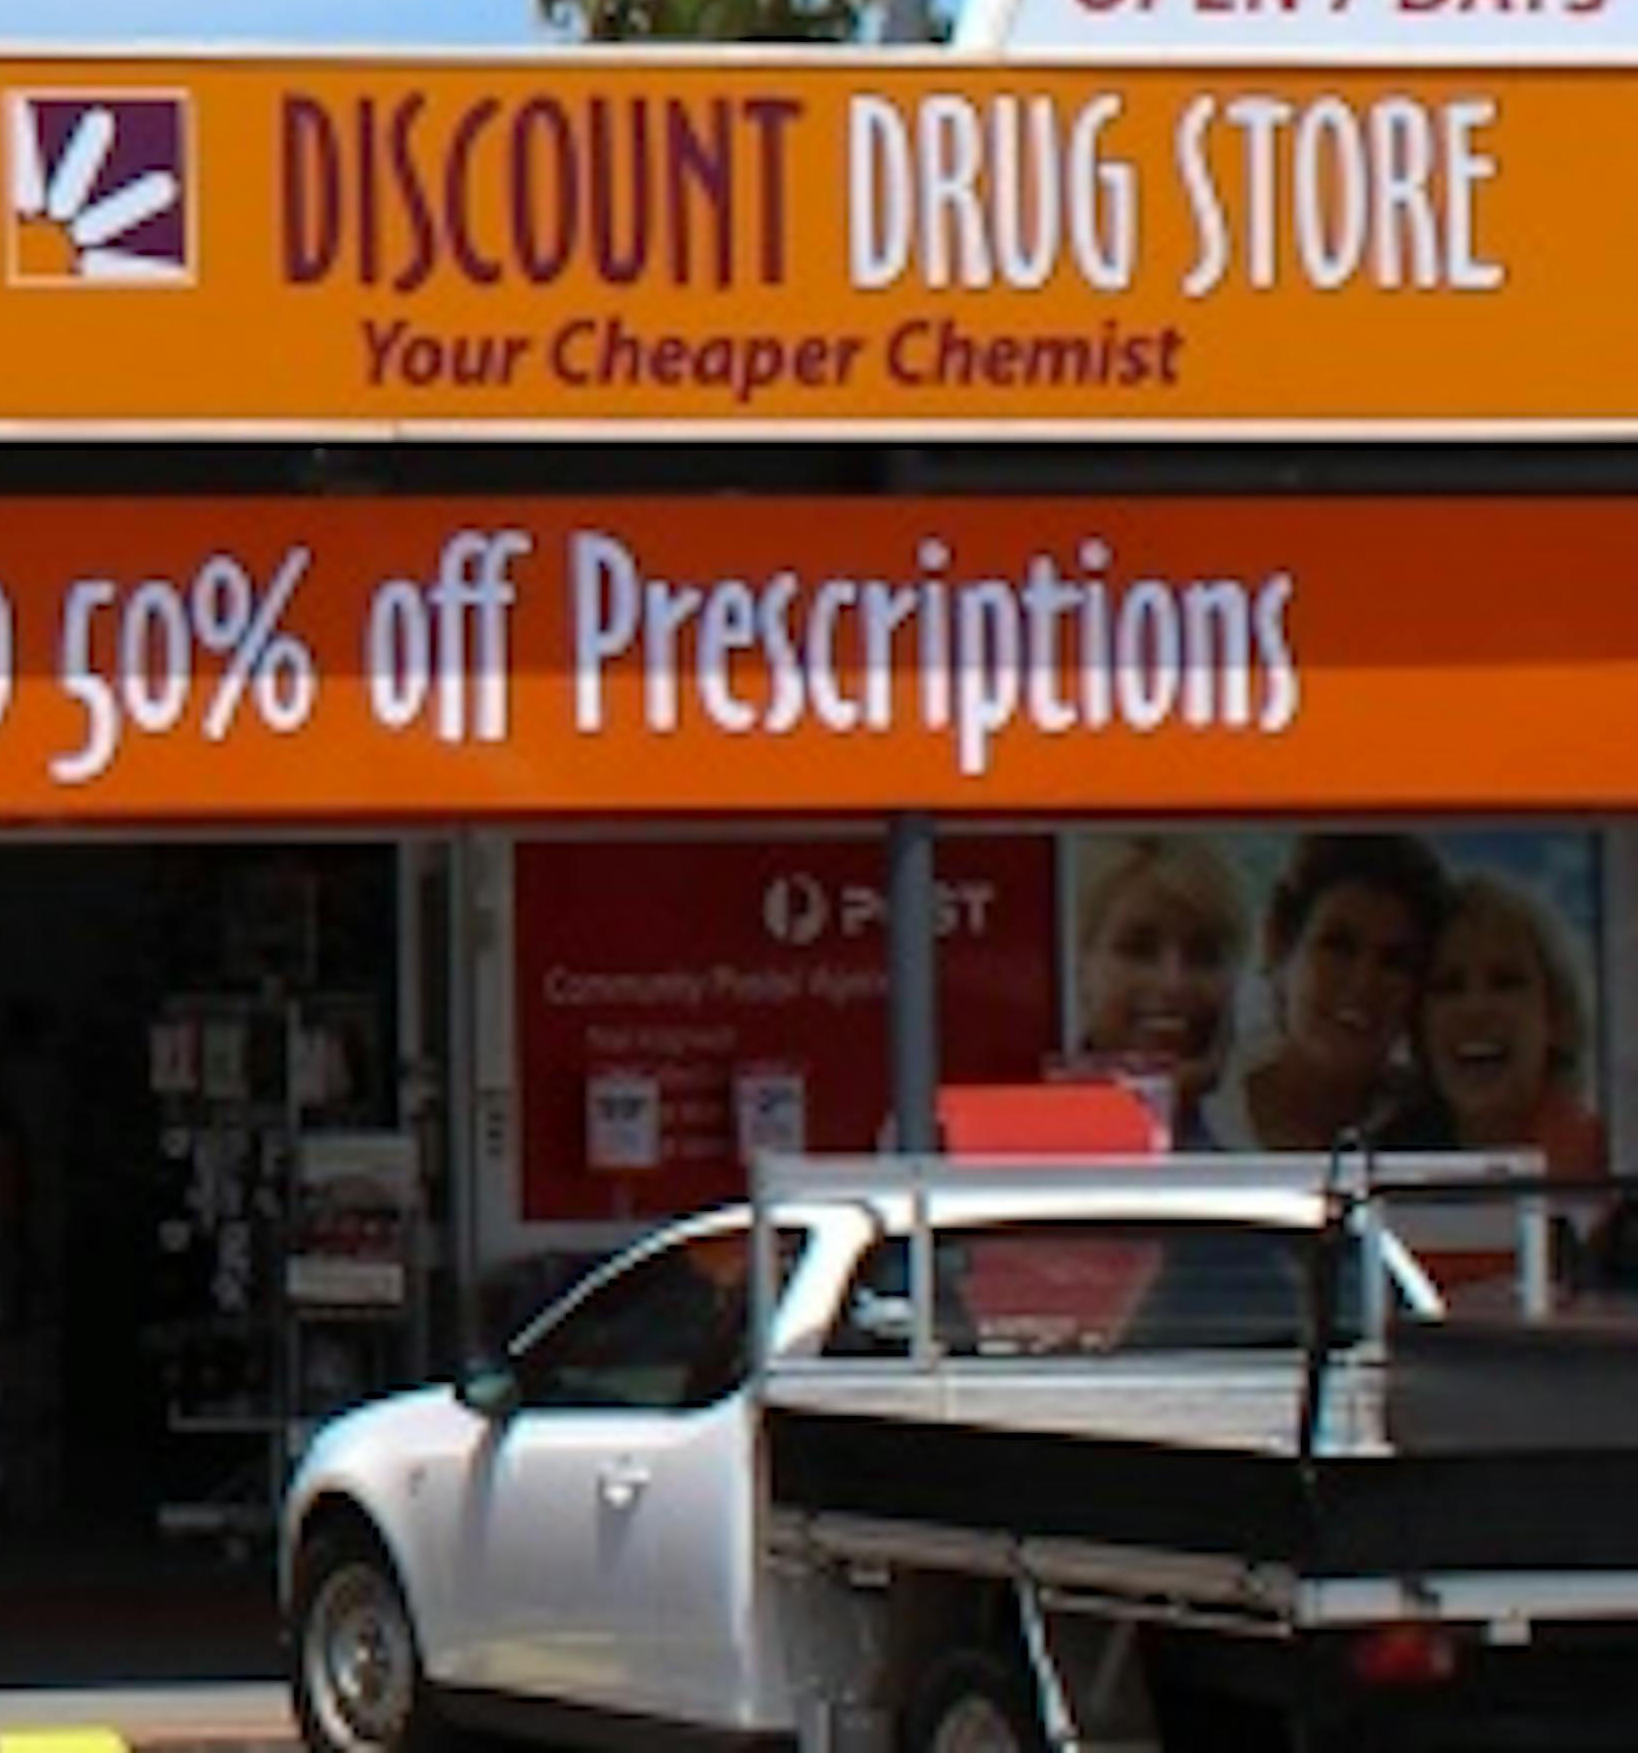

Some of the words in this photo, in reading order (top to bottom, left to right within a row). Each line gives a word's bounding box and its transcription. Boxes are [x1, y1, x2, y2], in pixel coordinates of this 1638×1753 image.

[278, 91, 802, 294] DISCOUNT
[848, 95, 1143, 292] DRUG
[1181, 95, 1507, 296] STORE
[359, 320, 531, 390] Your
[549, 320, 862, 404] Cheaper
[886, 320, 1183, 390] Chemist
[50, 543, 315, 786] 50%
[367, 530, 535, 745] off
[569, 536, 1298, 779] Prescriptions
[838, 880, 995, 938] PST
